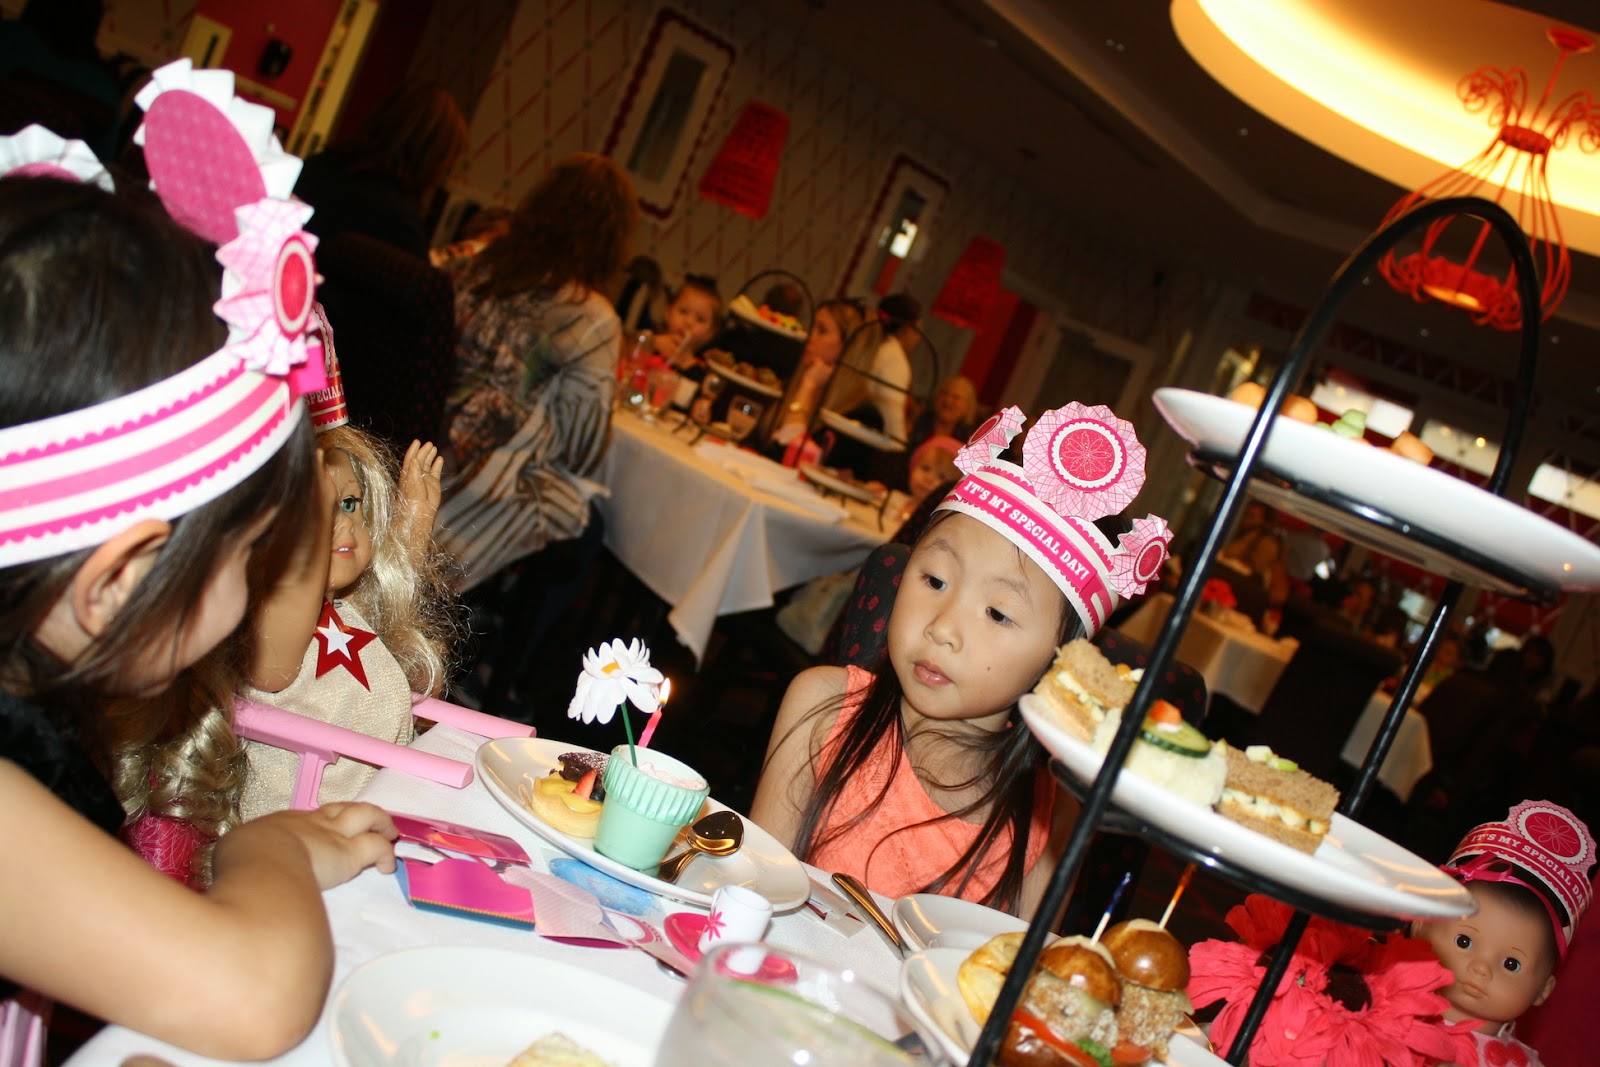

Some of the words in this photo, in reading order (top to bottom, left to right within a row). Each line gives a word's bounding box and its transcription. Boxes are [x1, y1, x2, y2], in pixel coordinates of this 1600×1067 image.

[963, 480, 991, 501] IT'S
[988, 494, 1013, 513] MY
[1008, 508, 1061, 556] SPECIAL
[1060, 549, 1091, 580] DAY!
[1470, 833, 1497, 843] IT'S
[1498, 836, 1521, 848] MY
[1522, 844, 1572, 887] SPECIAL
